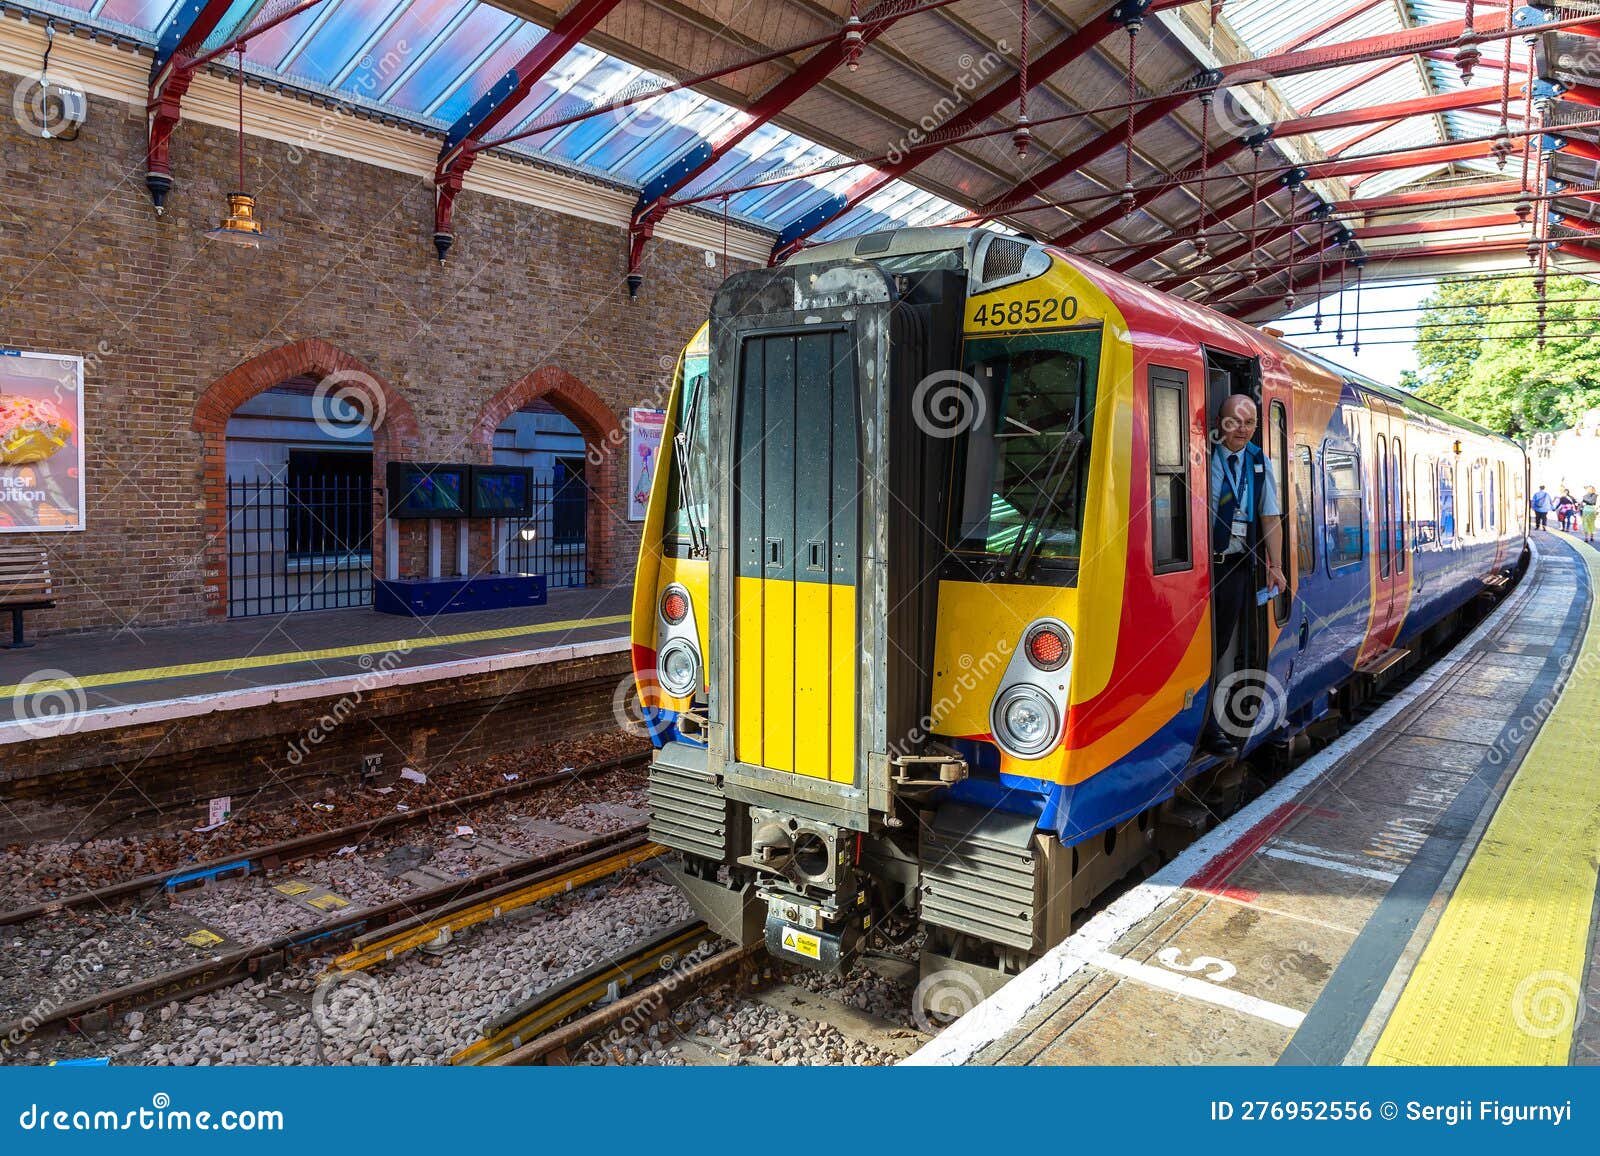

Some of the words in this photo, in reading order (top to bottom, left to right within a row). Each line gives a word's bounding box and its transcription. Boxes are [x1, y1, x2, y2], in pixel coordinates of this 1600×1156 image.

[972, 295, 1079, 327] 458520
[797, 937, 818, 948] Caution
[1157, 946, 1238, 982] S
